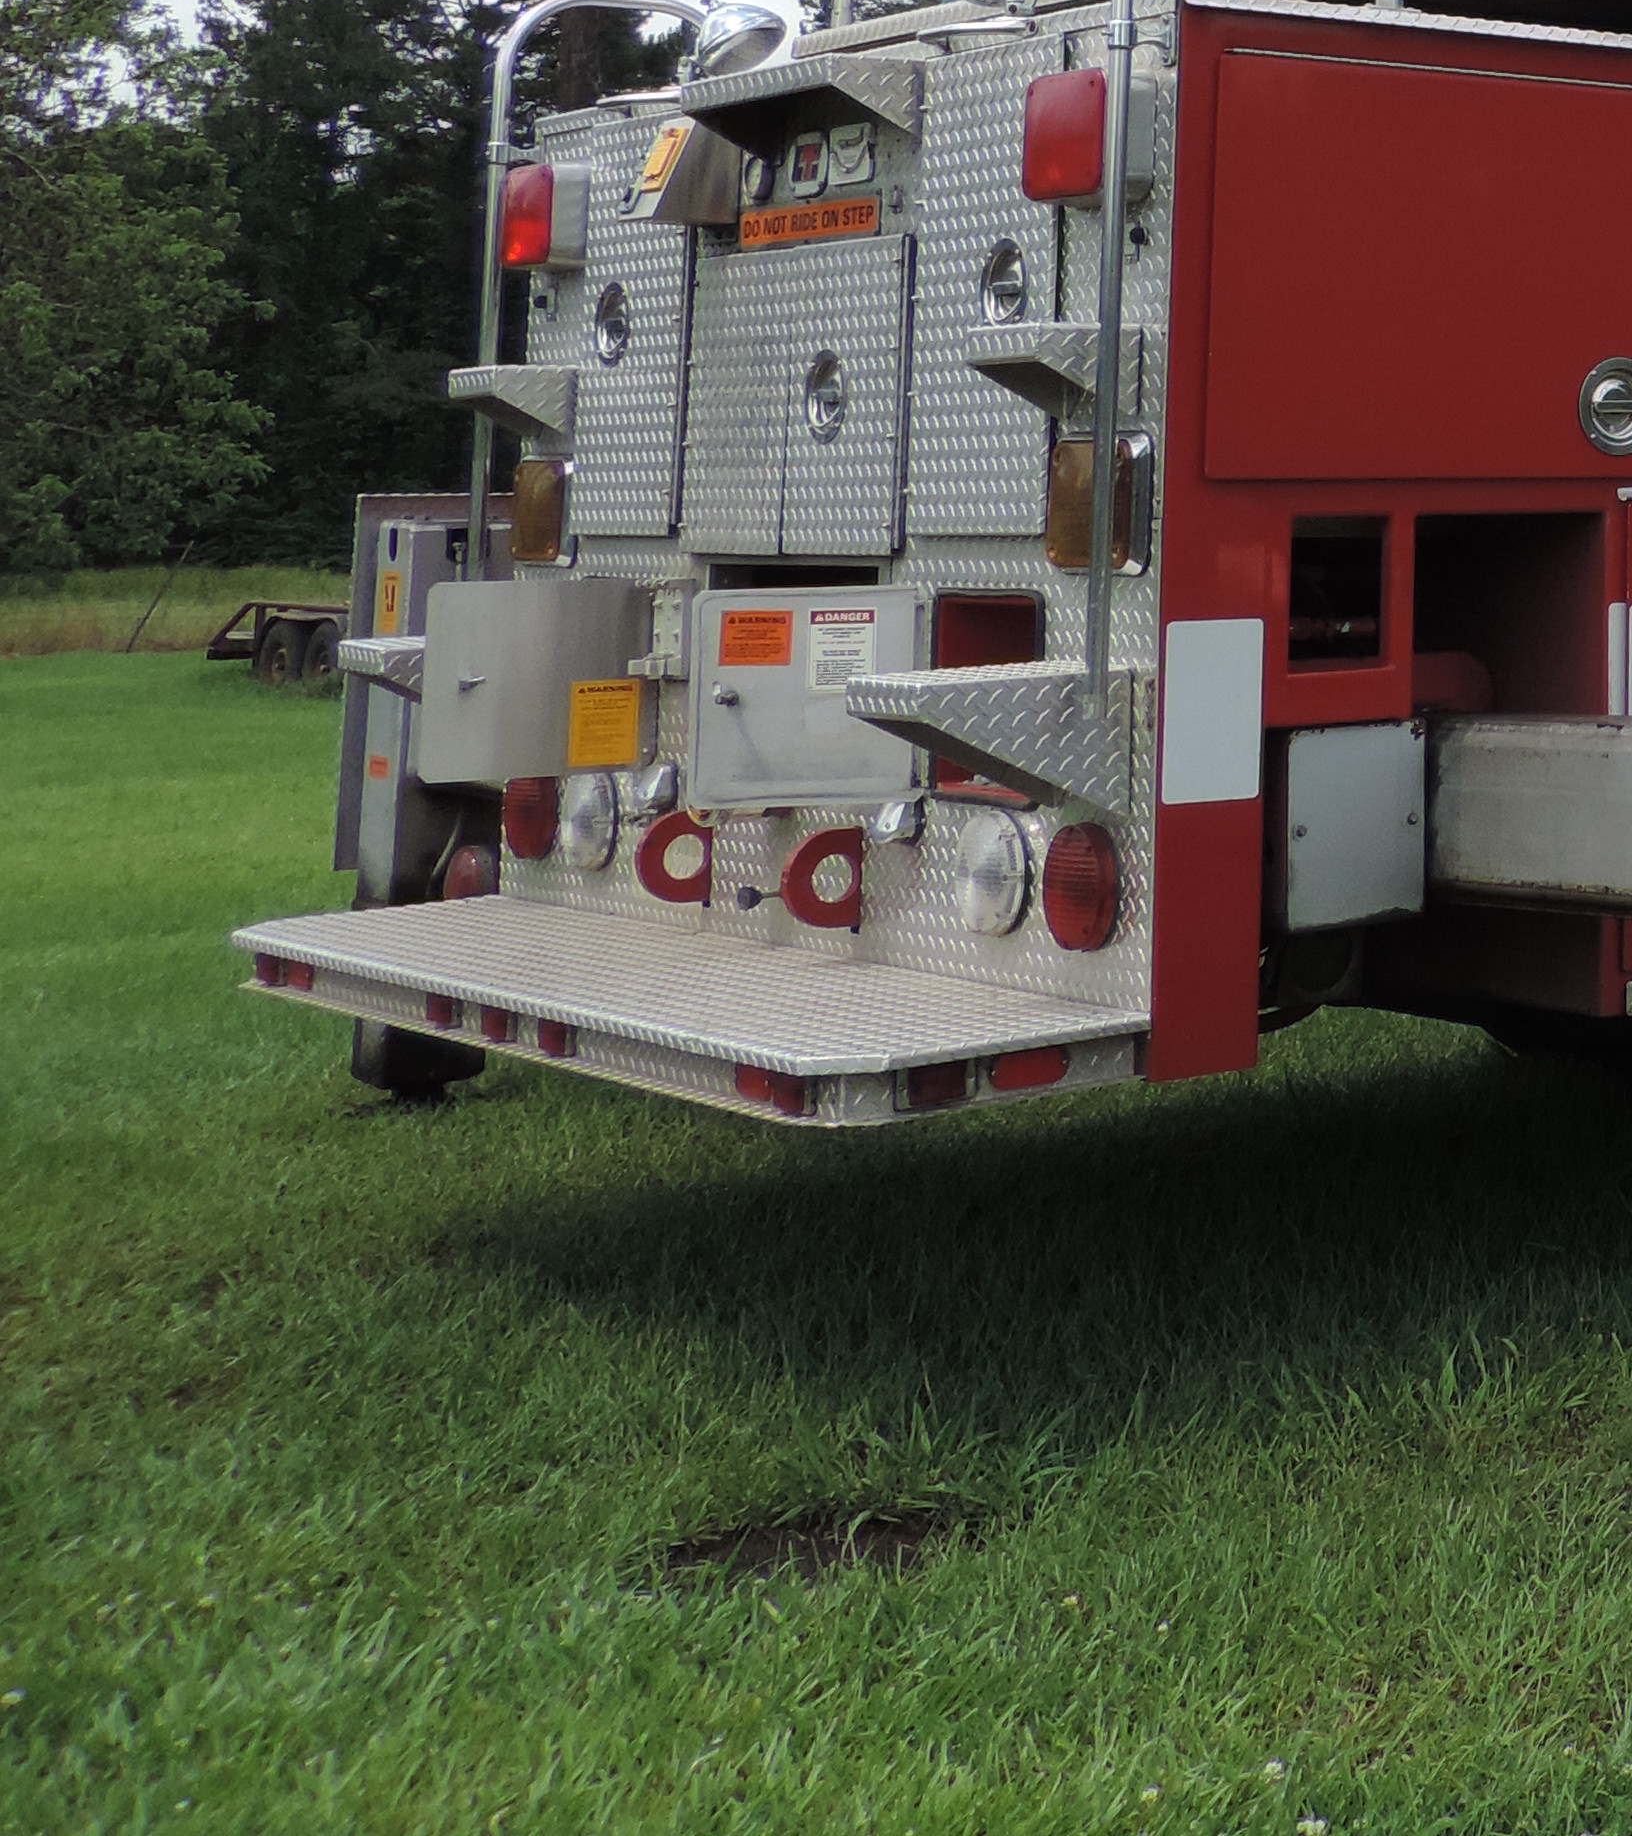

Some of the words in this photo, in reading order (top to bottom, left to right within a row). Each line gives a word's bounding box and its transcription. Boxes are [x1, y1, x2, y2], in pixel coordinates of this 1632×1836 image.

[743, 220, 760, 238] DO
[763, 215, 787, 235] NOT
[791, 211, 817, 231] RIDE
[822, 210, 839, 228] ON
[842, 205, 874, 225] STEP
[825, 612, 870, 622] DANGER
